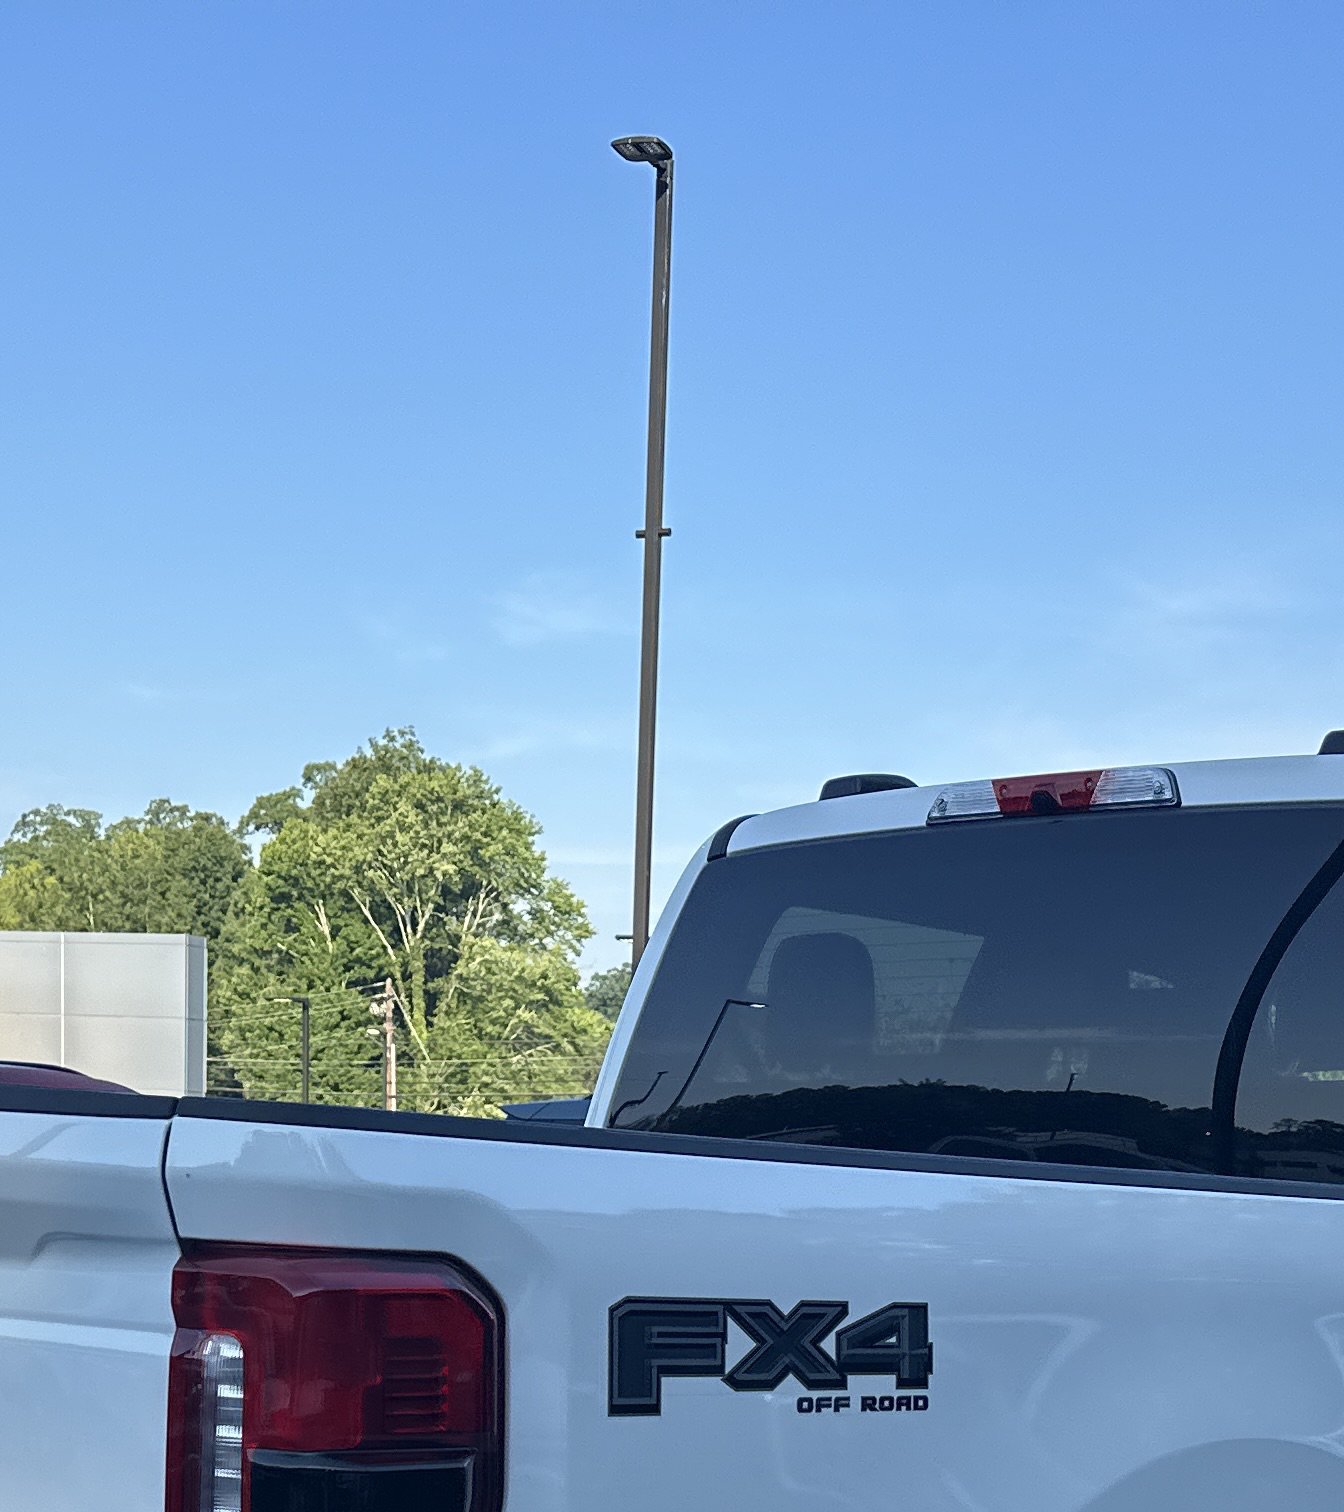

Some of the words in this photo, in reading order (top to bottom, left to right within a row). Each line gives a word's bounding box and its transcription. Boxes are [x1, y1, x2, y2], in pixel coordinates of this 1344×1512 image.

[608, 1296, 933, 1416] FX4
[796, 1396, 851, 1414] OFF
[860, 1395, 929, 1413] ROAD
